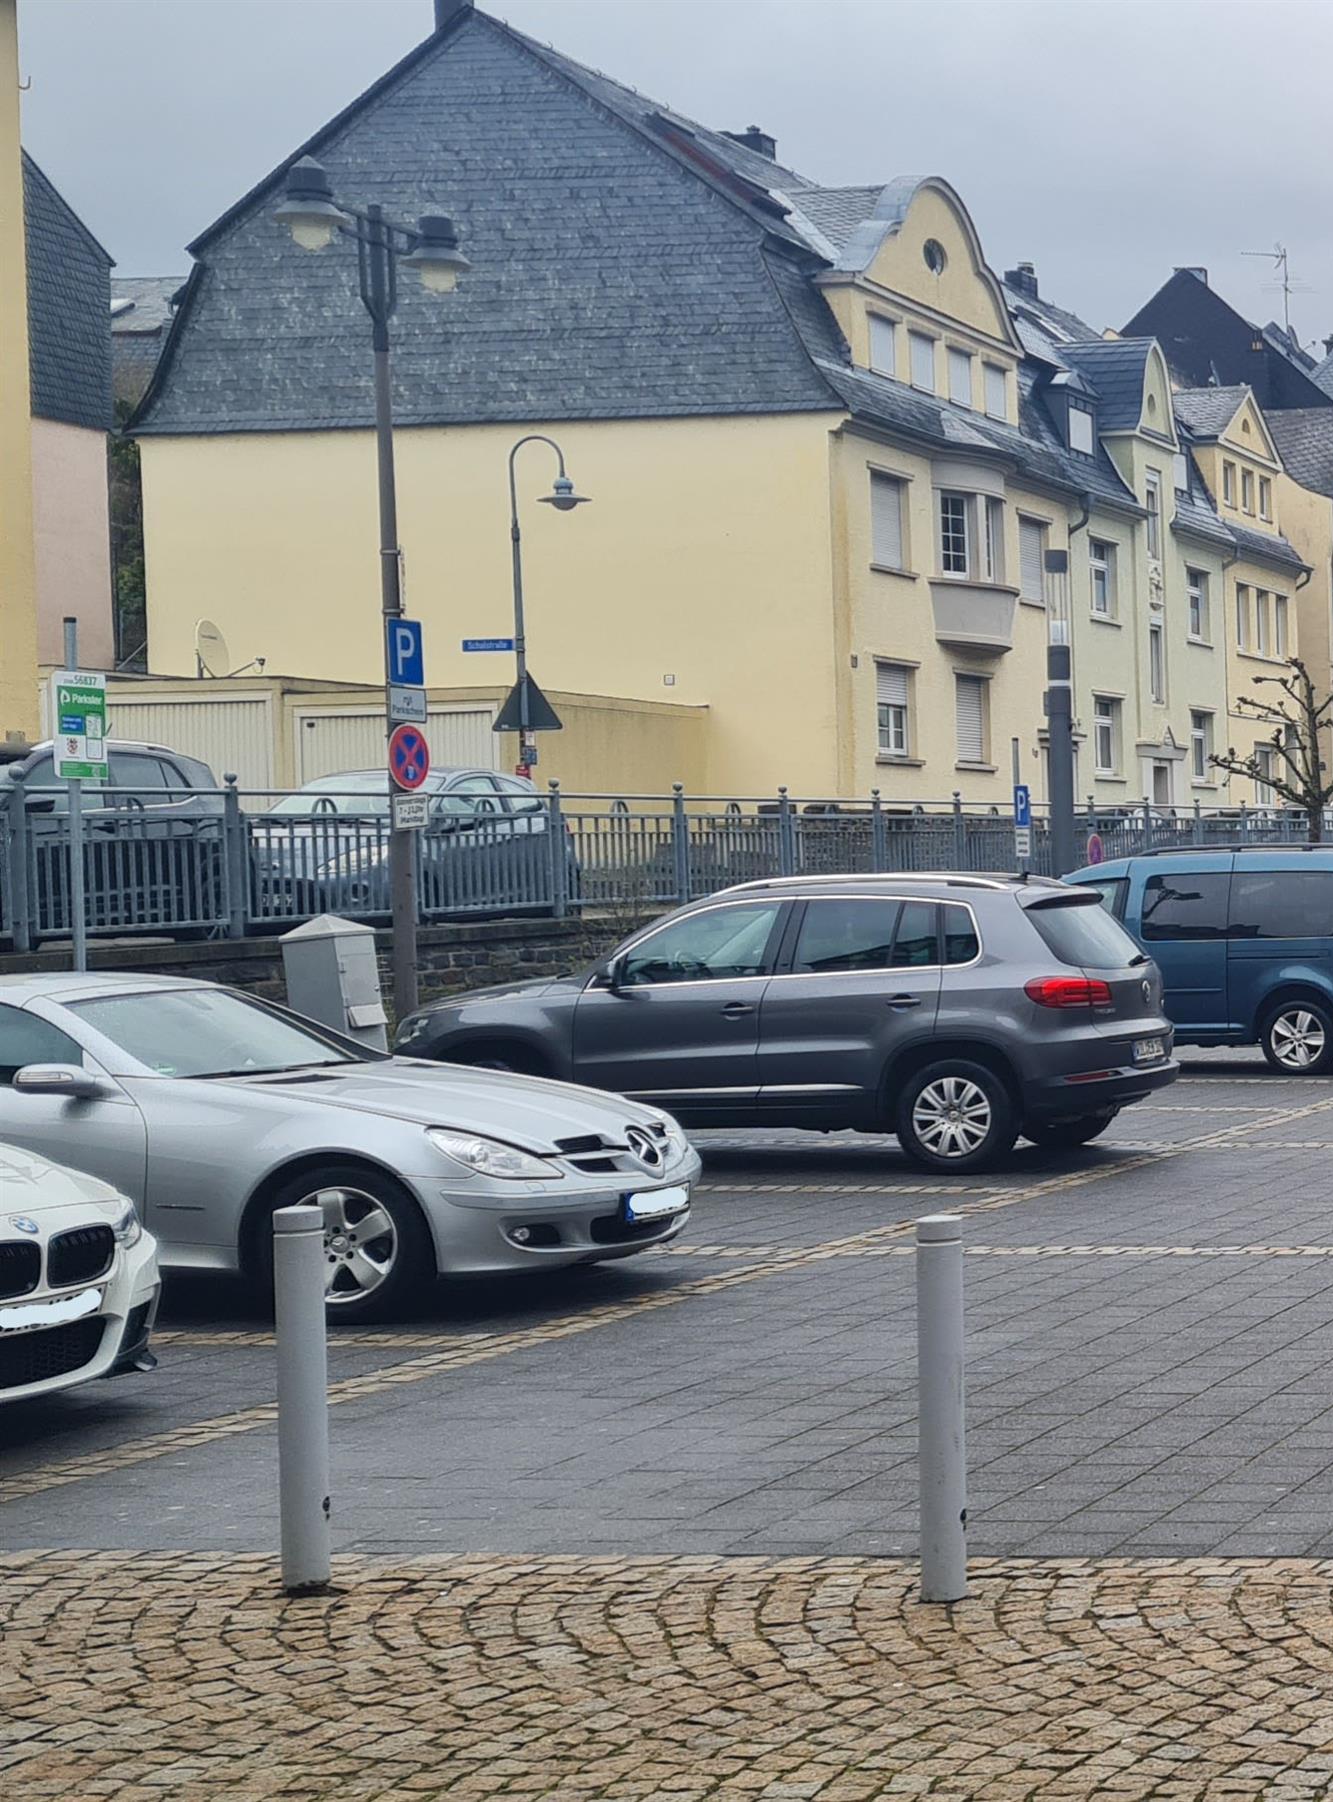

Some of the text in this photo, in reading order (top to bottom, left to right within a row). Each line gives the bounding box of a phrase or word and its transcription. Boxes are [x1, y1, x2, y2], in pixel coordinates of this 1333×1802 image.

[396, 628, 415, 676] P
[72, 693, 103, 705] Parkster
[1017, 790, 1026, 821] P
